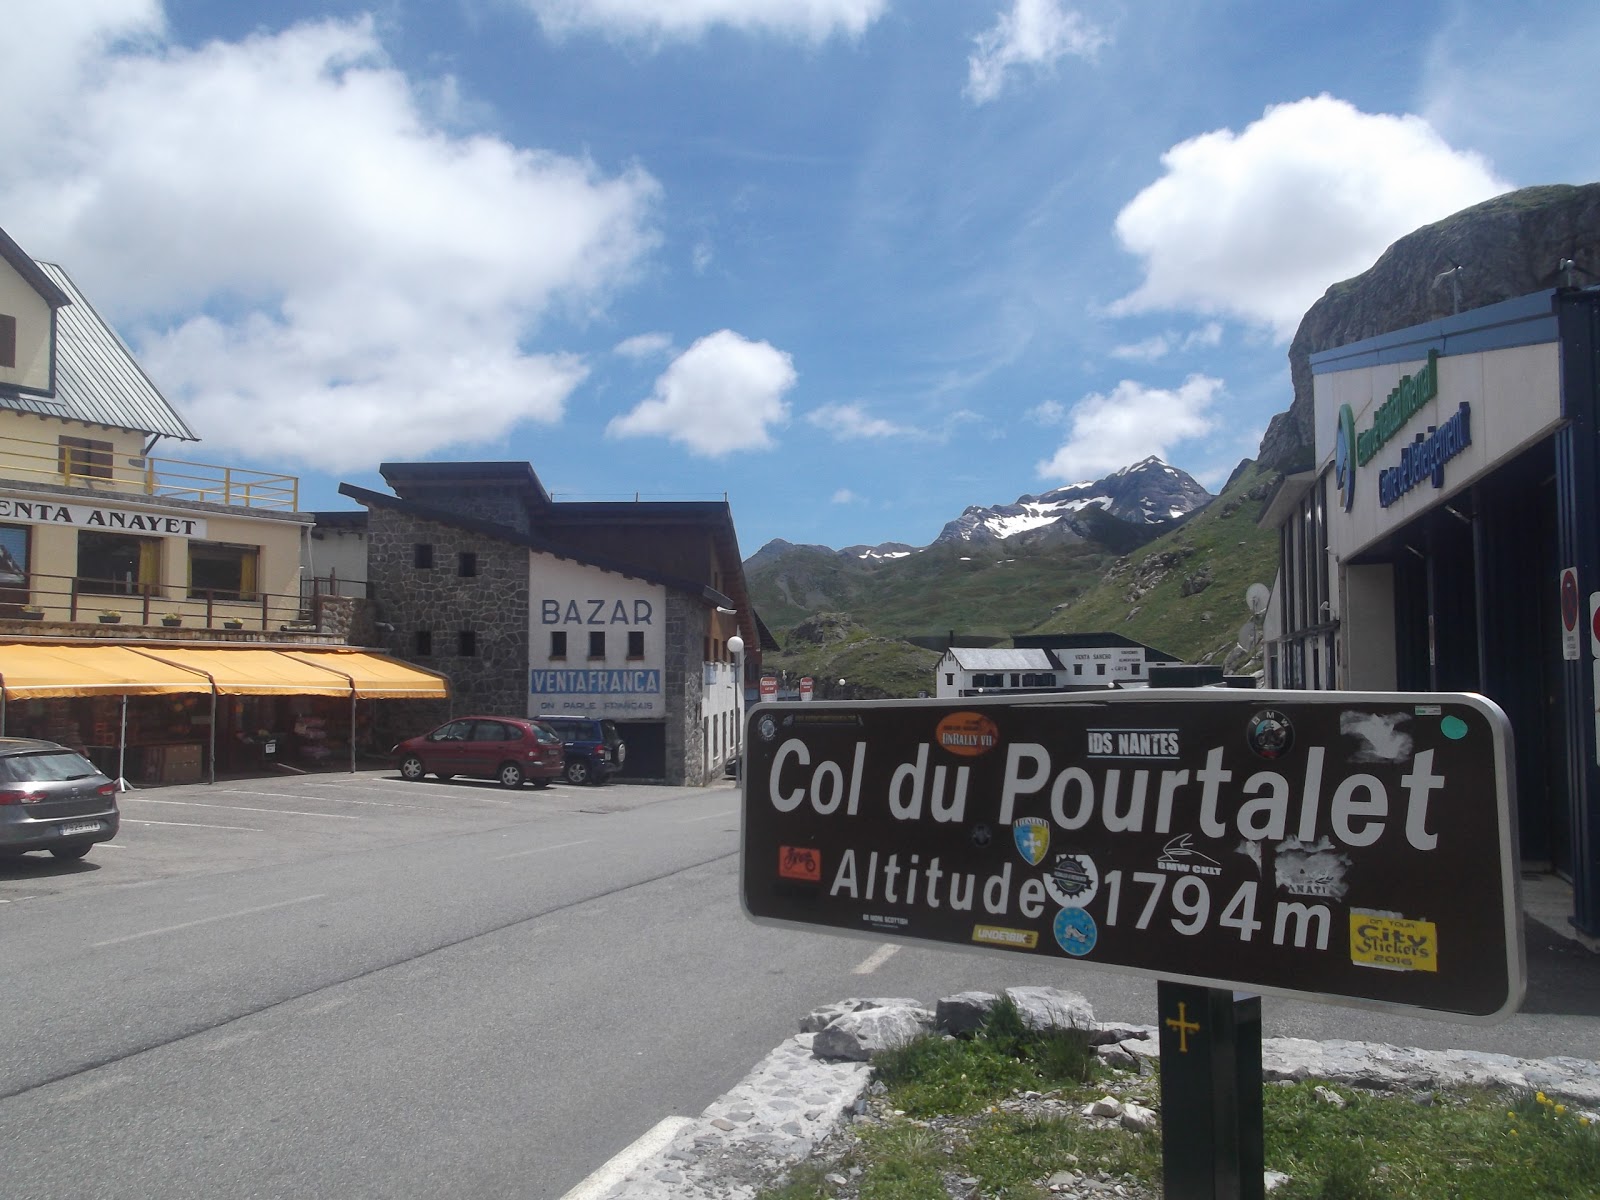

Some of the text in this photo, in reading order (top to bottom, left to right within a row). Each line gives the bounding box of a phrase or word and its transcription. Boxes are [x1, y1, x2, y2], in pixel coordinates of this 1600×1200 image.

[0, 501, 196, 535] ENTA ANAYET
[541, 599, 653, 625] BAZAR
[533, 671, 658, 693] VENTAFRANCA
[563, 702, 597, 710] PARLE
[1118, 732, 1179, 755] NANTES
[769, 738, 1445, 851] Col du Pourtalet
[1158, 862, 1190, 873] BMW
[829, 849, 1331, 950] Altitude 1794 m
[1356, 937, 1429, 958] Slickers
